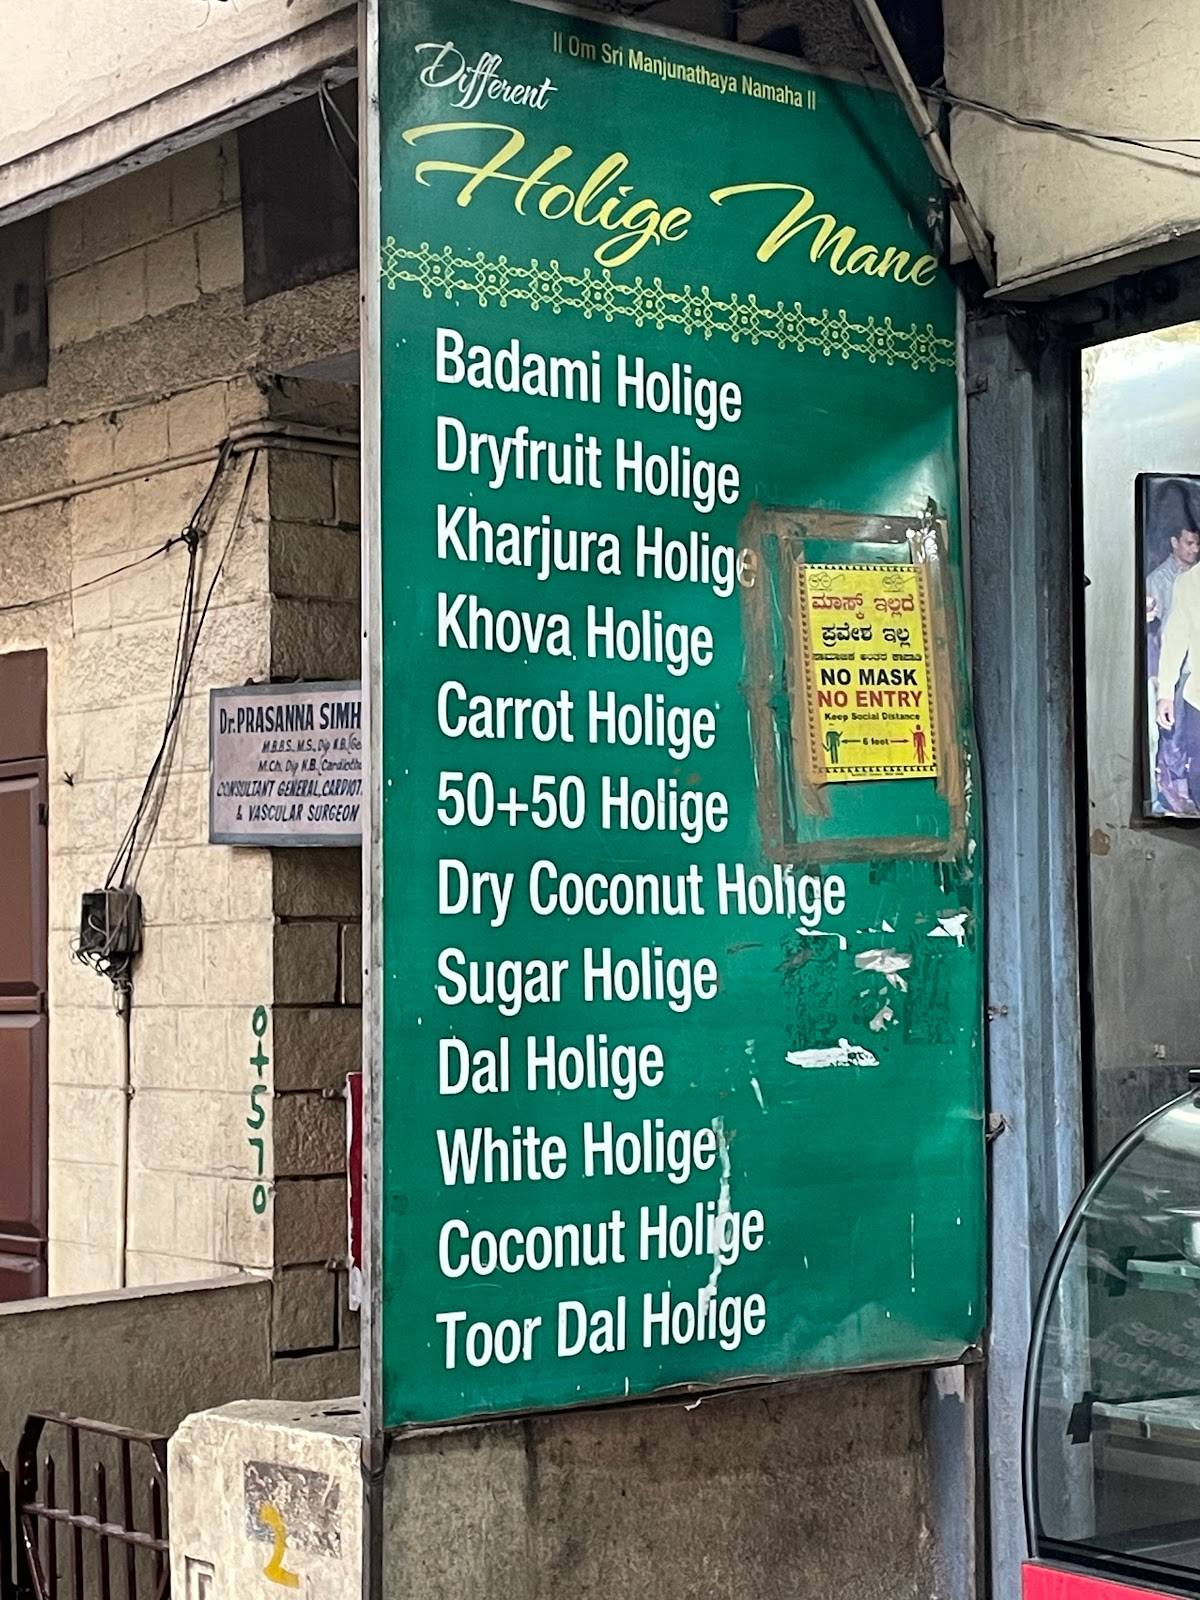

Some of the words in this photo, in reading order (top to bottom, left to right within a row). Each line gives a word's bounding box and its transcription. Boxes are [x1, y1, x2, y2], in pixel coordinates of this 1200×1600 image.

[414, 41, 559, 110] Different
[569, 35, 597, 60] Om
[601, 42, 623, 67] Sri
[628, 48, 737, 95] Manjunathaya
[742, 75, 803, 109] Namaha
[402, 121, 692, 268] Holige
[709, 182, 939, 286] Mane
[436, 327, 601, 404] Badami
[617, 354, 742, 431] Holige
[437, 415, 602, 489] Dryfruit
[616, 438, 740, 513] Holige
[437, 504, 622, 581] Kharjura
[636, 524, 758, 598] Holige
[438, 592, 572, 657] Khova
[587, 604, 713, 677] Holige
[882, 627, 911, 649] ಇಲ್ಲ
[816, 690, 848, 708] NO
[855, 690, 923, 708] ENTRY
[821, 668, 852, 686] NO
[858, 668, 918, 686] MASK
[437, 680, 574, 743] Carrot
[588, 690, 716, 760] Holige
[824, 712, 849, 722] Keep
[851, 712, 880, 721] Social
[881, 711, 920, 721] Distance
[862, 737, 869, 746] 6
[216, 779, 276, 798] CONSULTANT
[236, 803, 243, 821] &
[247, 803, 304, 823] VASCULAR
[307, 803, 361, 823] SURGEON
[437, 771, 586, 829] 50+50
[602, 776, 728, 844] Holige
[439, 859, 514, 928] Dry
[529, 859, 705, 916] Coconut
[717, 863, 846, 927] Holige
[437, 947, 569, 1017] Sugar
[583, 946, 718, 1013] Holige
[439, 1035, 509, 1095] Dal
[527, 1033, 664, 1100] Holige
[436, 1125, 567, 1186] White
[583, 1118, 717, 1184] Holige
[439, 1210, 626, 1278] Coconut
[640, 1201, 764, 1266] Holige
[436, 1311, 542, 1369] Toor
[557, 1296, 626, 1357] Dal
[643, 1287, 766, 1351] Holige
